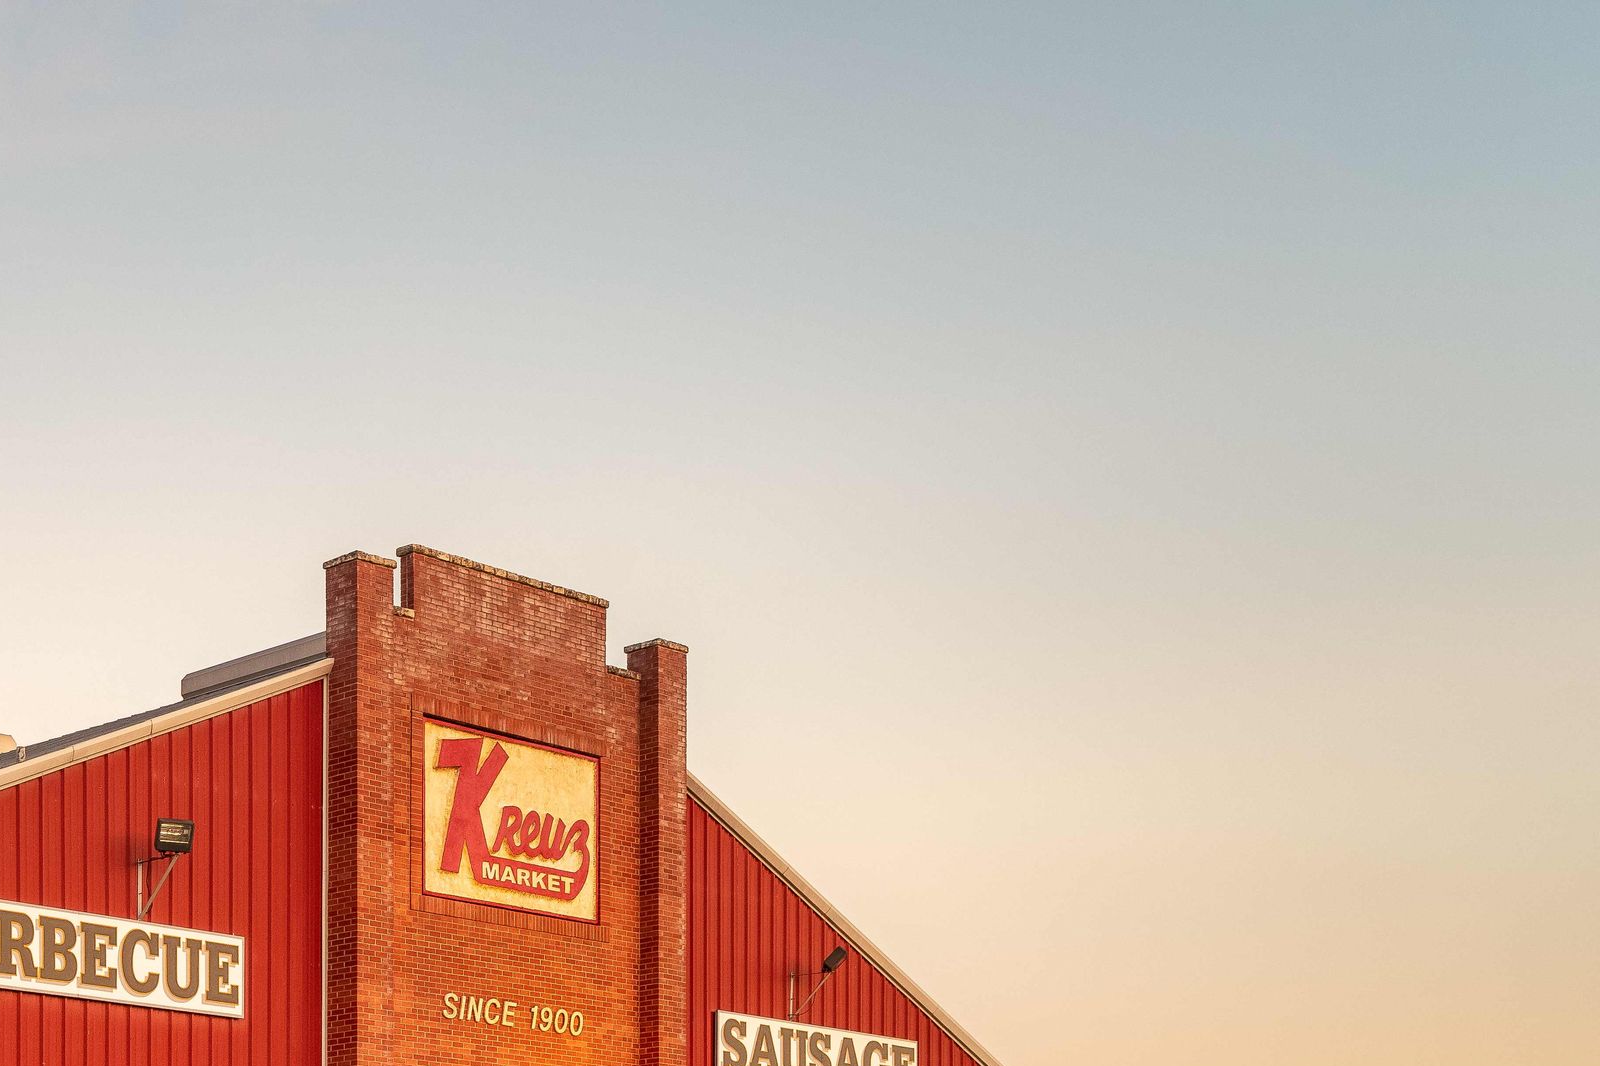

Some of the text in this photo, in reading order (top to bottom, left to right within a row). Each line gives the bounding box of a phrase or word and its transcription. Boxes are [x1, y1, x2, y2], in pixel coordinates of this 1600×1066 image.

[436, 737, 591, 900] Kreuz
[480, 860, 576, 895] MARKET
[441, 992, 584, 1036] SINCE 1900
